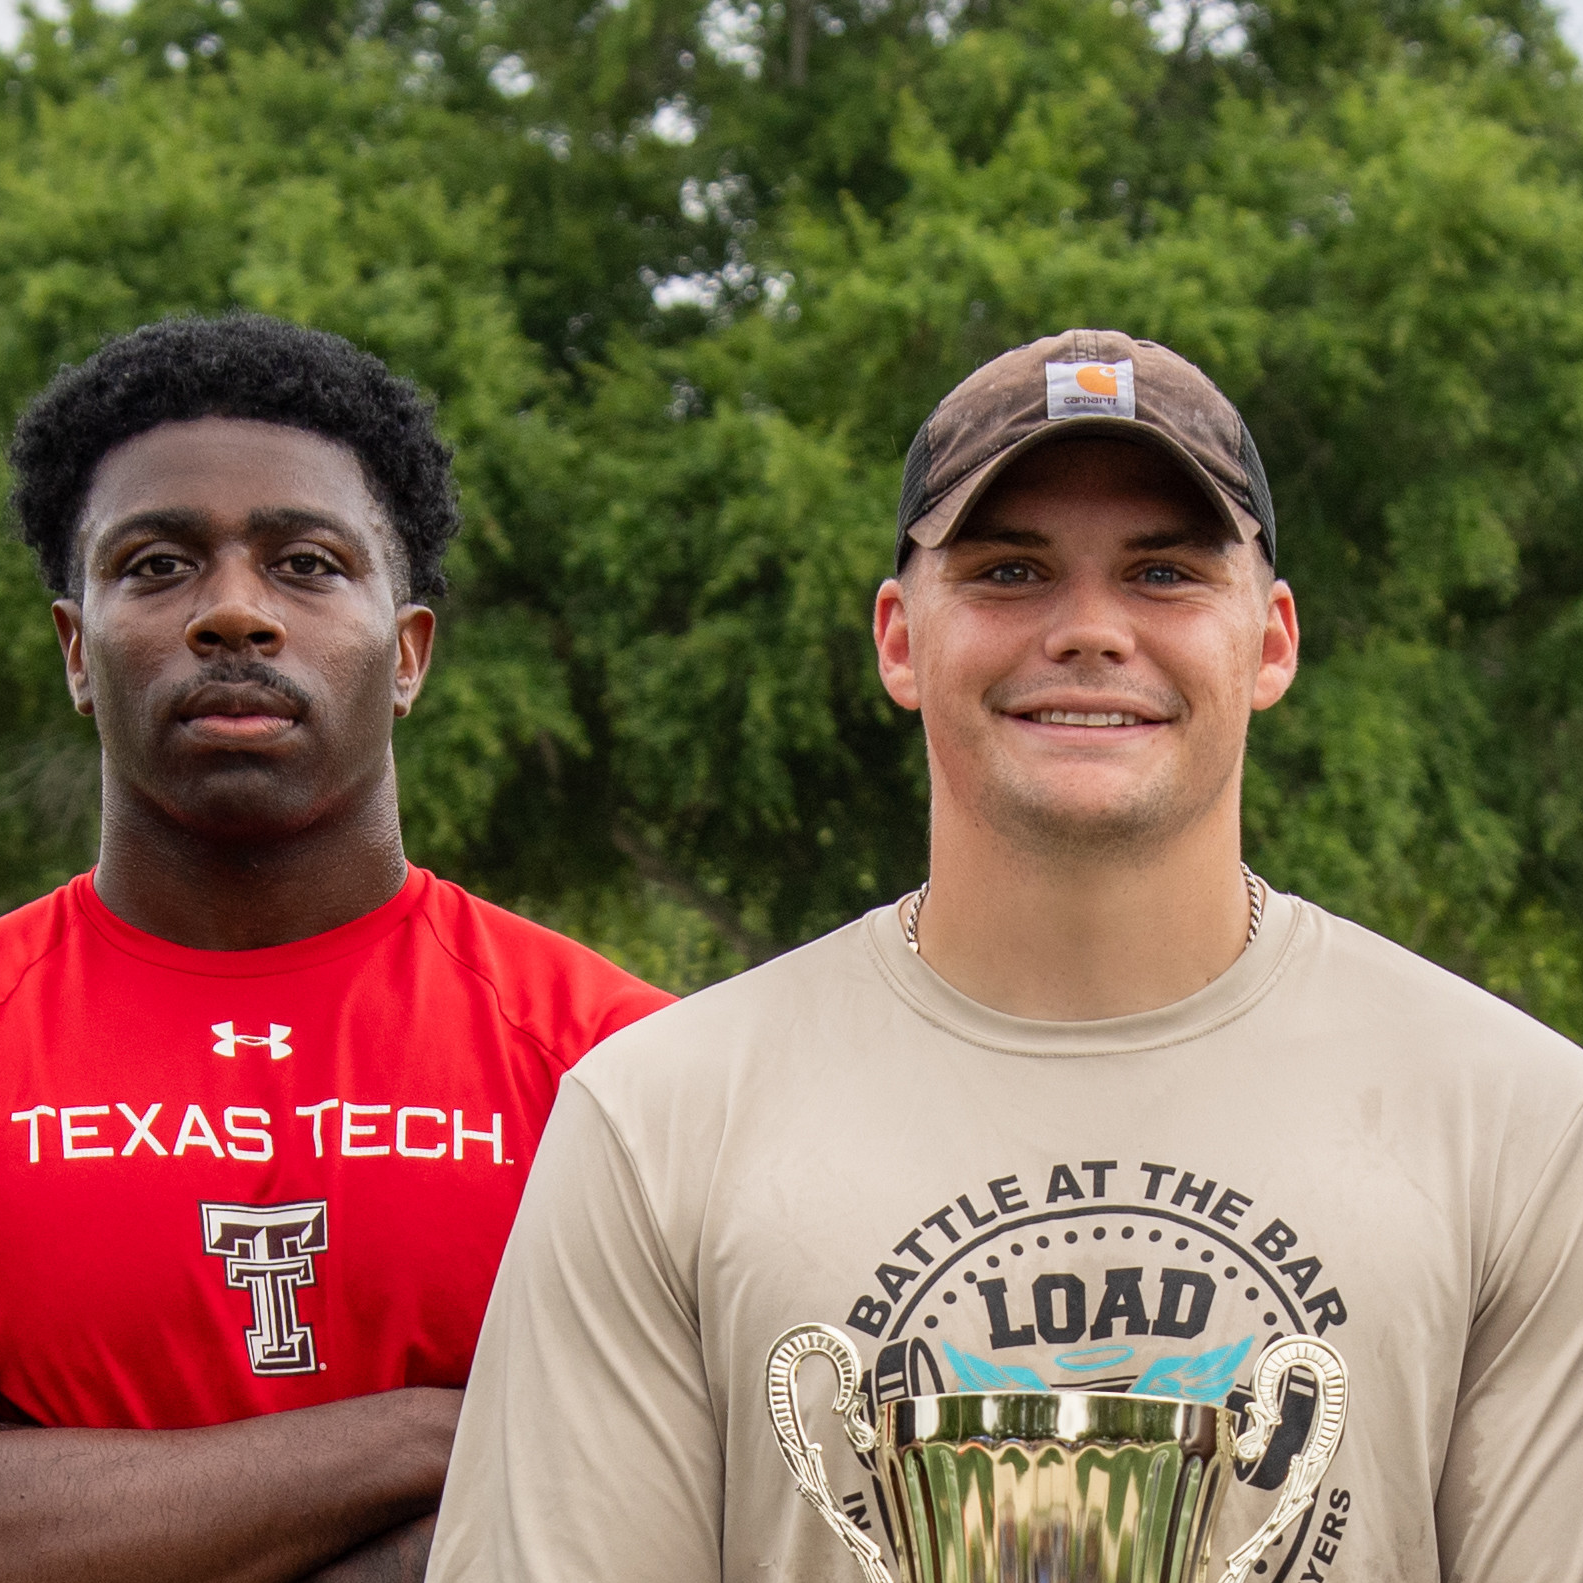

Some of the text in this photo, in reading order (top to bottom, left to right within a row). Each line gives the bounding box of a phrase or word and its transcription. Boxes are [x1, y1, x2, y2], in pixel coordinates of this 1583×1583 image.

[11, 1101, 273, 1163] TEXAS
[845, 1160, 1348, 1339] BATTLE AT THE BAR
[976, 1266, 1217, 1350] LOAD
